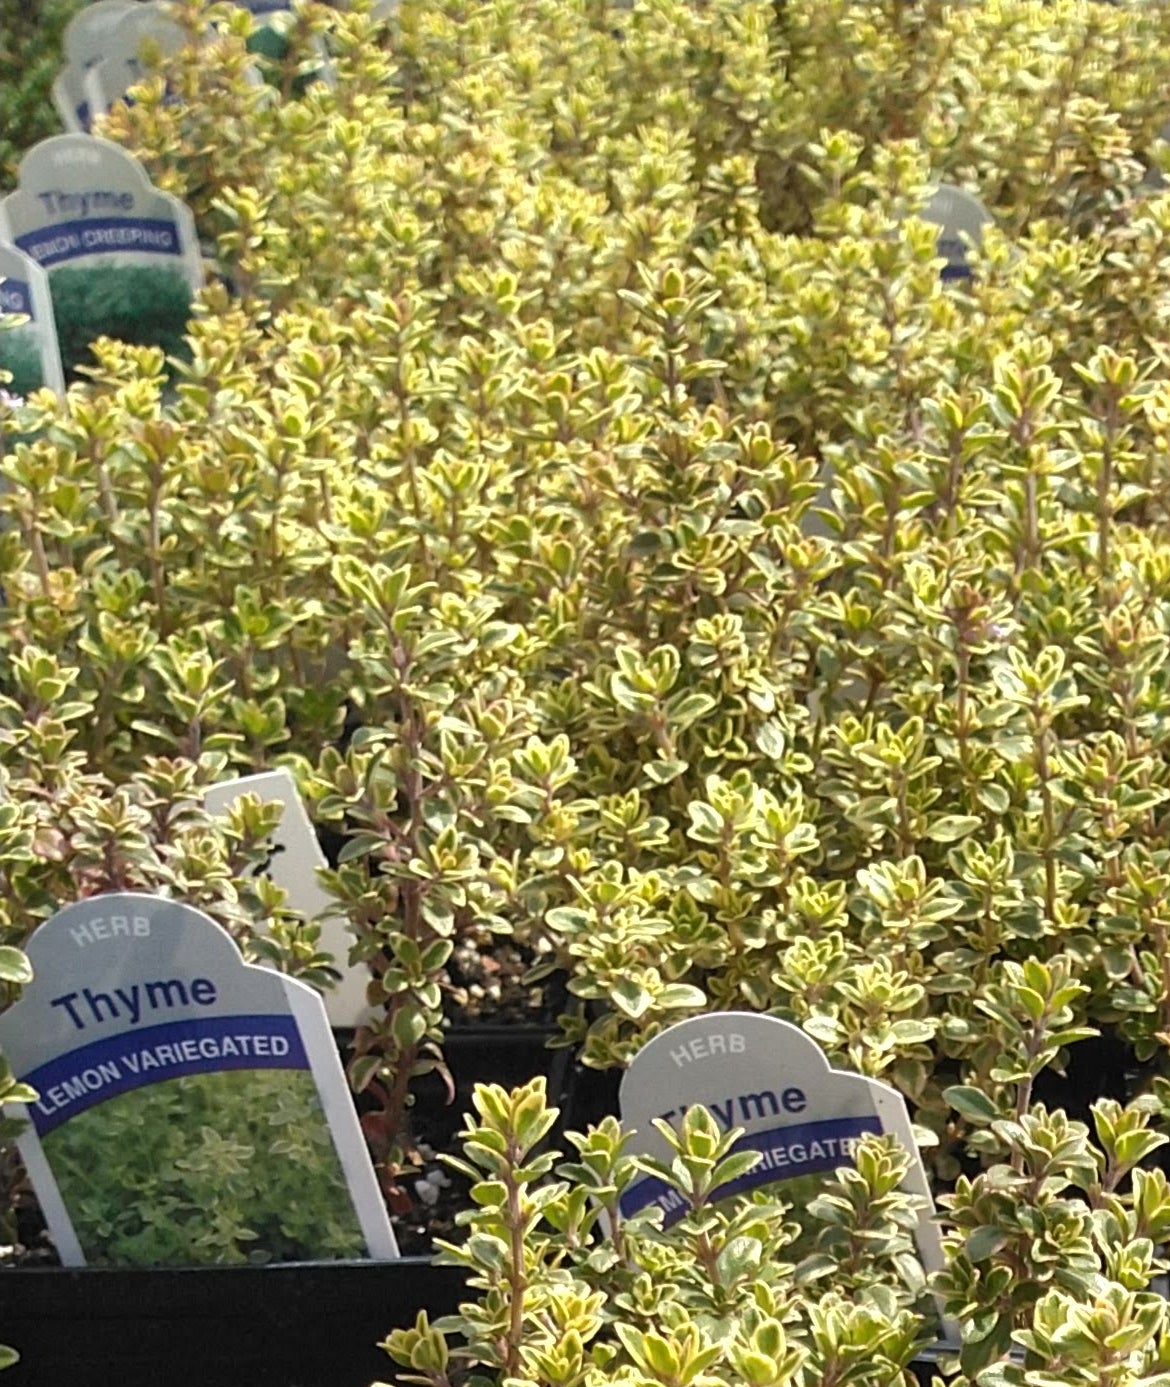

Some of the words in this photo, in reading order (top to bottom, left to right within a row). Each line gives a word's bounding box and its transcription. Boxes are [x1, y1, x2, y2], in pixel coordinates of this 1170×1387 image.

[70, 915, 151, 948] HERB
[51, 977, 218, 1031] Thyme
[668, 1033, 747, 1068] HERB
[38, 1060, 121, 1117] LEMON
[121, 1034, 290, 1074] VARIEGATED
